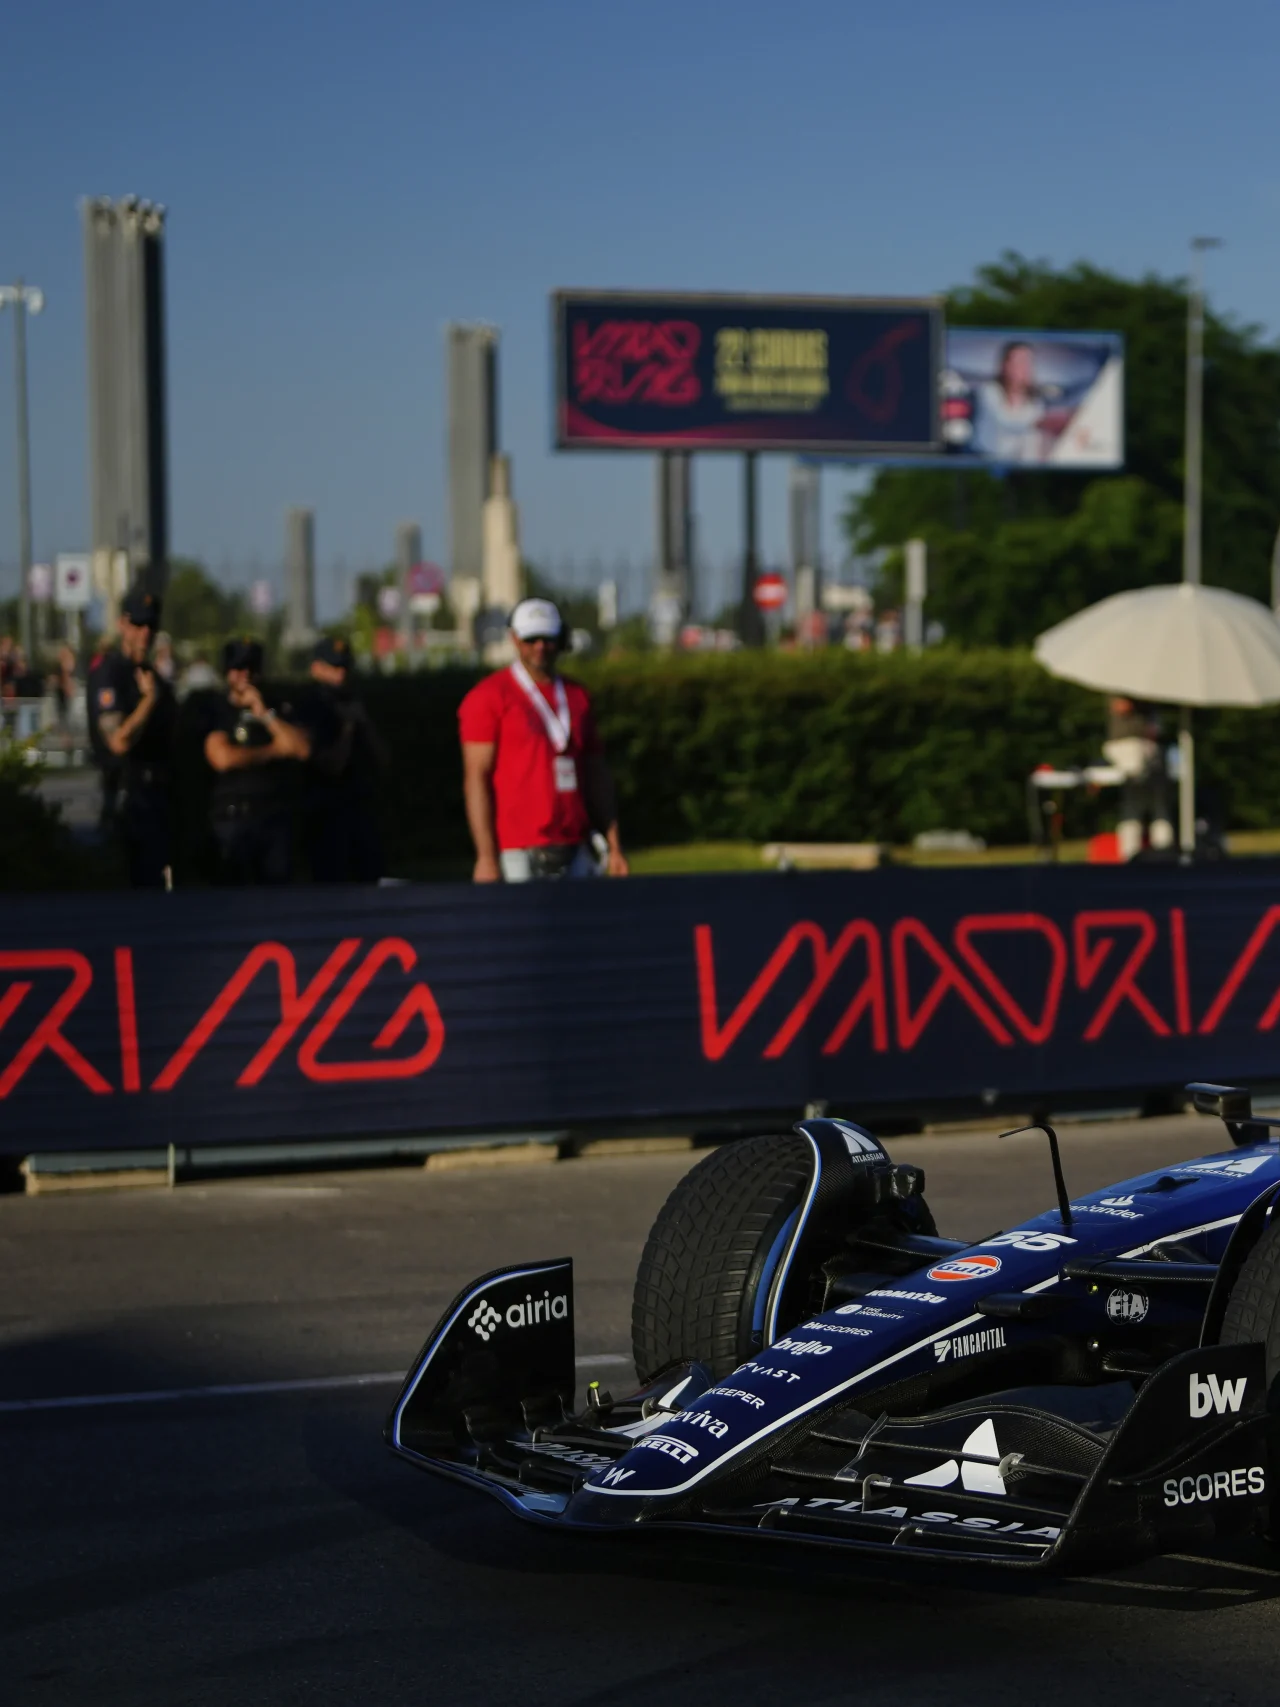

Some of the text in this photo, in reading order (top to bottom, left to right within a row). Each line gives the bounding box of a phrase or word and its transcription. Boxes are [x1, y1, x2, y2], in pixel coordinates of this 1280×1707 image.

[0, 937, 446, 1098] RING
[852, 1152, 885, 1164] ATLASSIAN
[936, 1262, 994, 1276] Gulf
[506, 1290, 568, 1328] airia
[865, 1289, 948, 1304] KOMATSU
[823, 1325, 874, 1336] SCORES
[953, 1327, 1007, 1359] FANCAPITAL
[751, 1365, 801, 1383] VAST
[708, 1387, 766, 1410] KEEPER
[1189, 1373, 1248, 1419] bw
[1163, 1466, 1265, 1507] SCORES
[752, 1497, 1064, 1540] ATLASSIA
